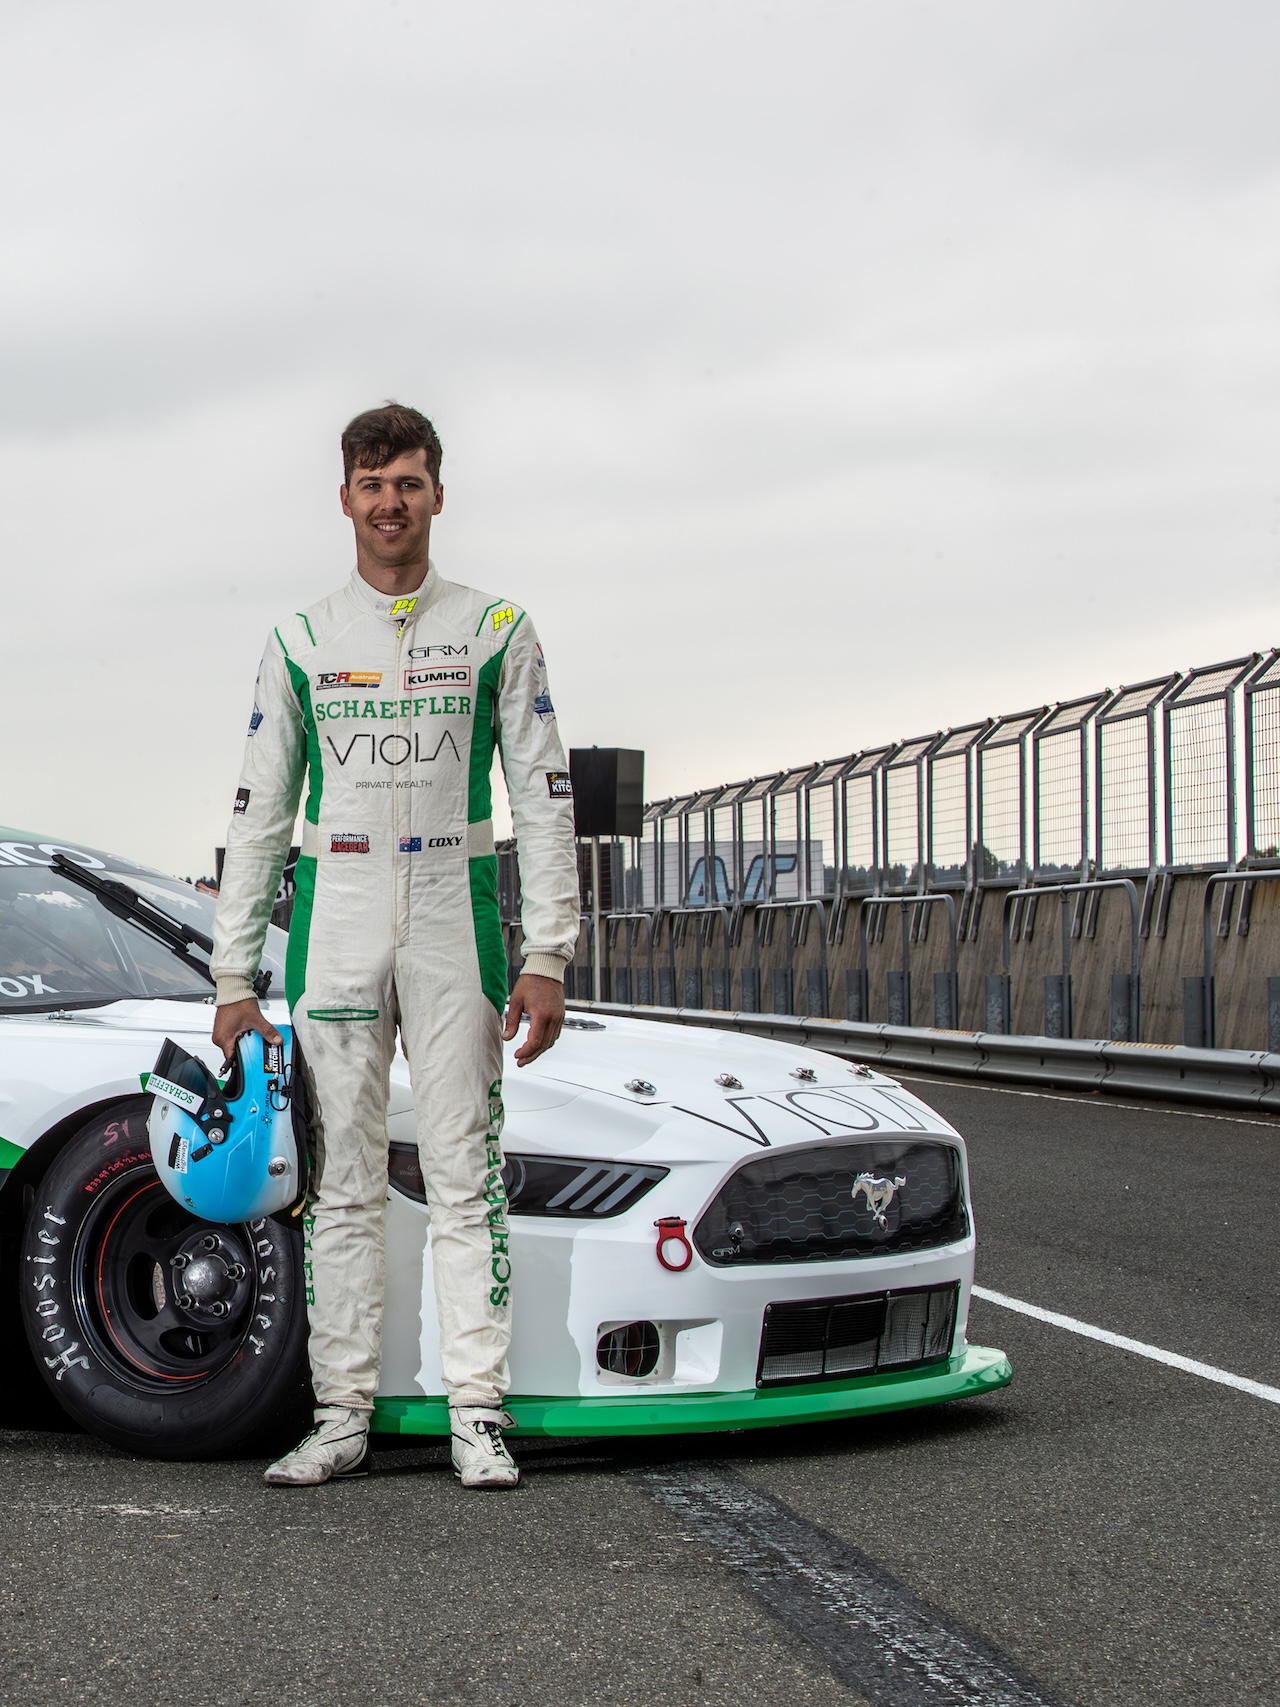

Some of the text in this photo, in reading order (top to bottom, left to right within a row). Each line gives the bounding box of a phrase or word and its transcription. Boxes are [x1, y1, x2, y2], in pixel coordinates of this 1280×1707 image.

[390, 597, 418, 615] P1
[491, 607, 514, 631] P1
[408, 645, 468, 659] GRM
[318, 672, 350, 684] TCR
[408, 671, 467, 685] KUMHO
[315, 696, 471, 721] SCHAEFFLER
[326, 730, 461, 766] VIOLA
[355, 780, 433, 790] PRIVATE WEALTH
[332, 835, 368, 843] PERFORMANCE
[428, 836, 463, 848] COXY
[271, 1045, 279, 1072] KITCHE
[670, 1087, 960, 1147] VIOLA
[27, 1205, 90, 1381] Hoosier
[250, 1217, 288, 1356] oosier
